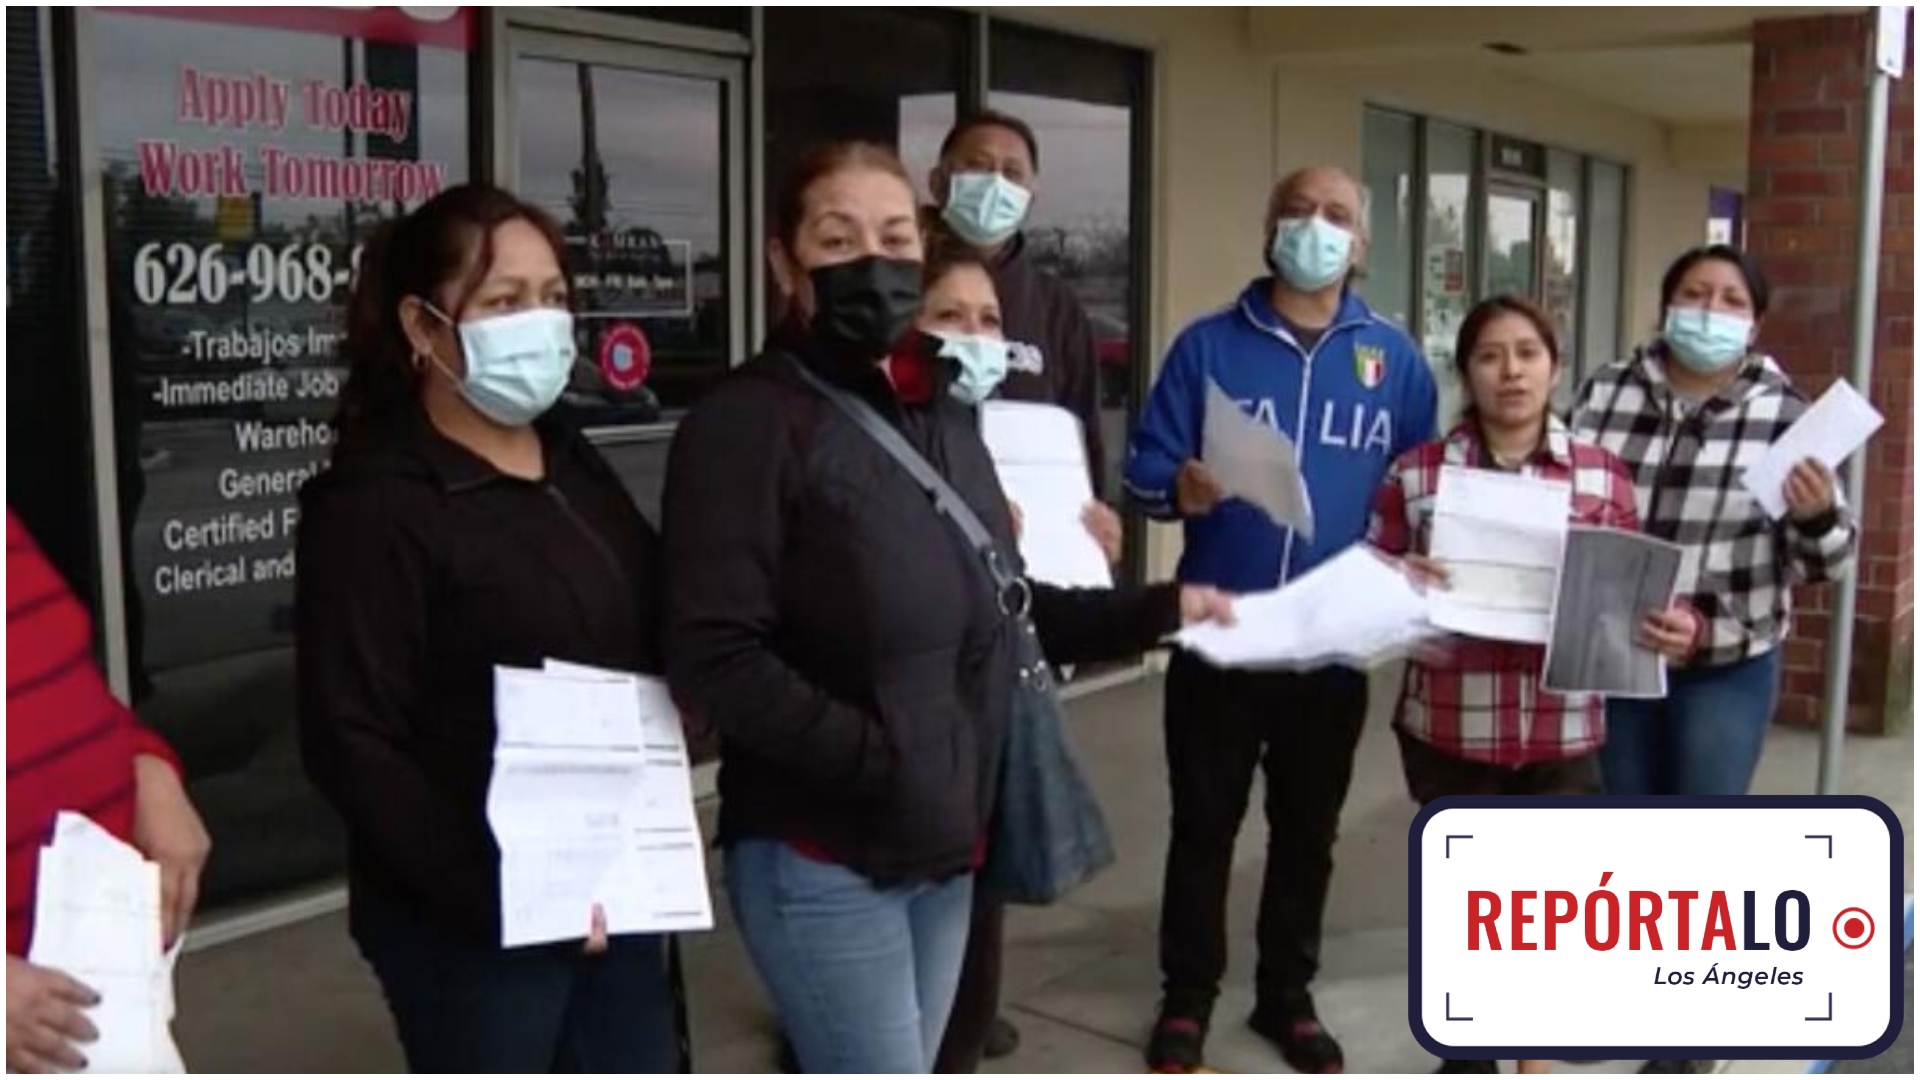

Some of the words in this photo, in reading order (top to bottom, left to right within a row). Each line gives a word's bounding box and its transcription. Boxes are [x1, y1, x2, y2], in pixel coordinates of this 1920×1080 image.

[180, 67, 287, 126] Apply
[303, 80, 409, 140] Today
[138, 141, 245, 196] Work
[261, 146, 446, 201] Tomorrow
[164, 509, 274, 550] Certified
[155, 554, 246, 594] Clerical
[253, 551, 296, 582] and
